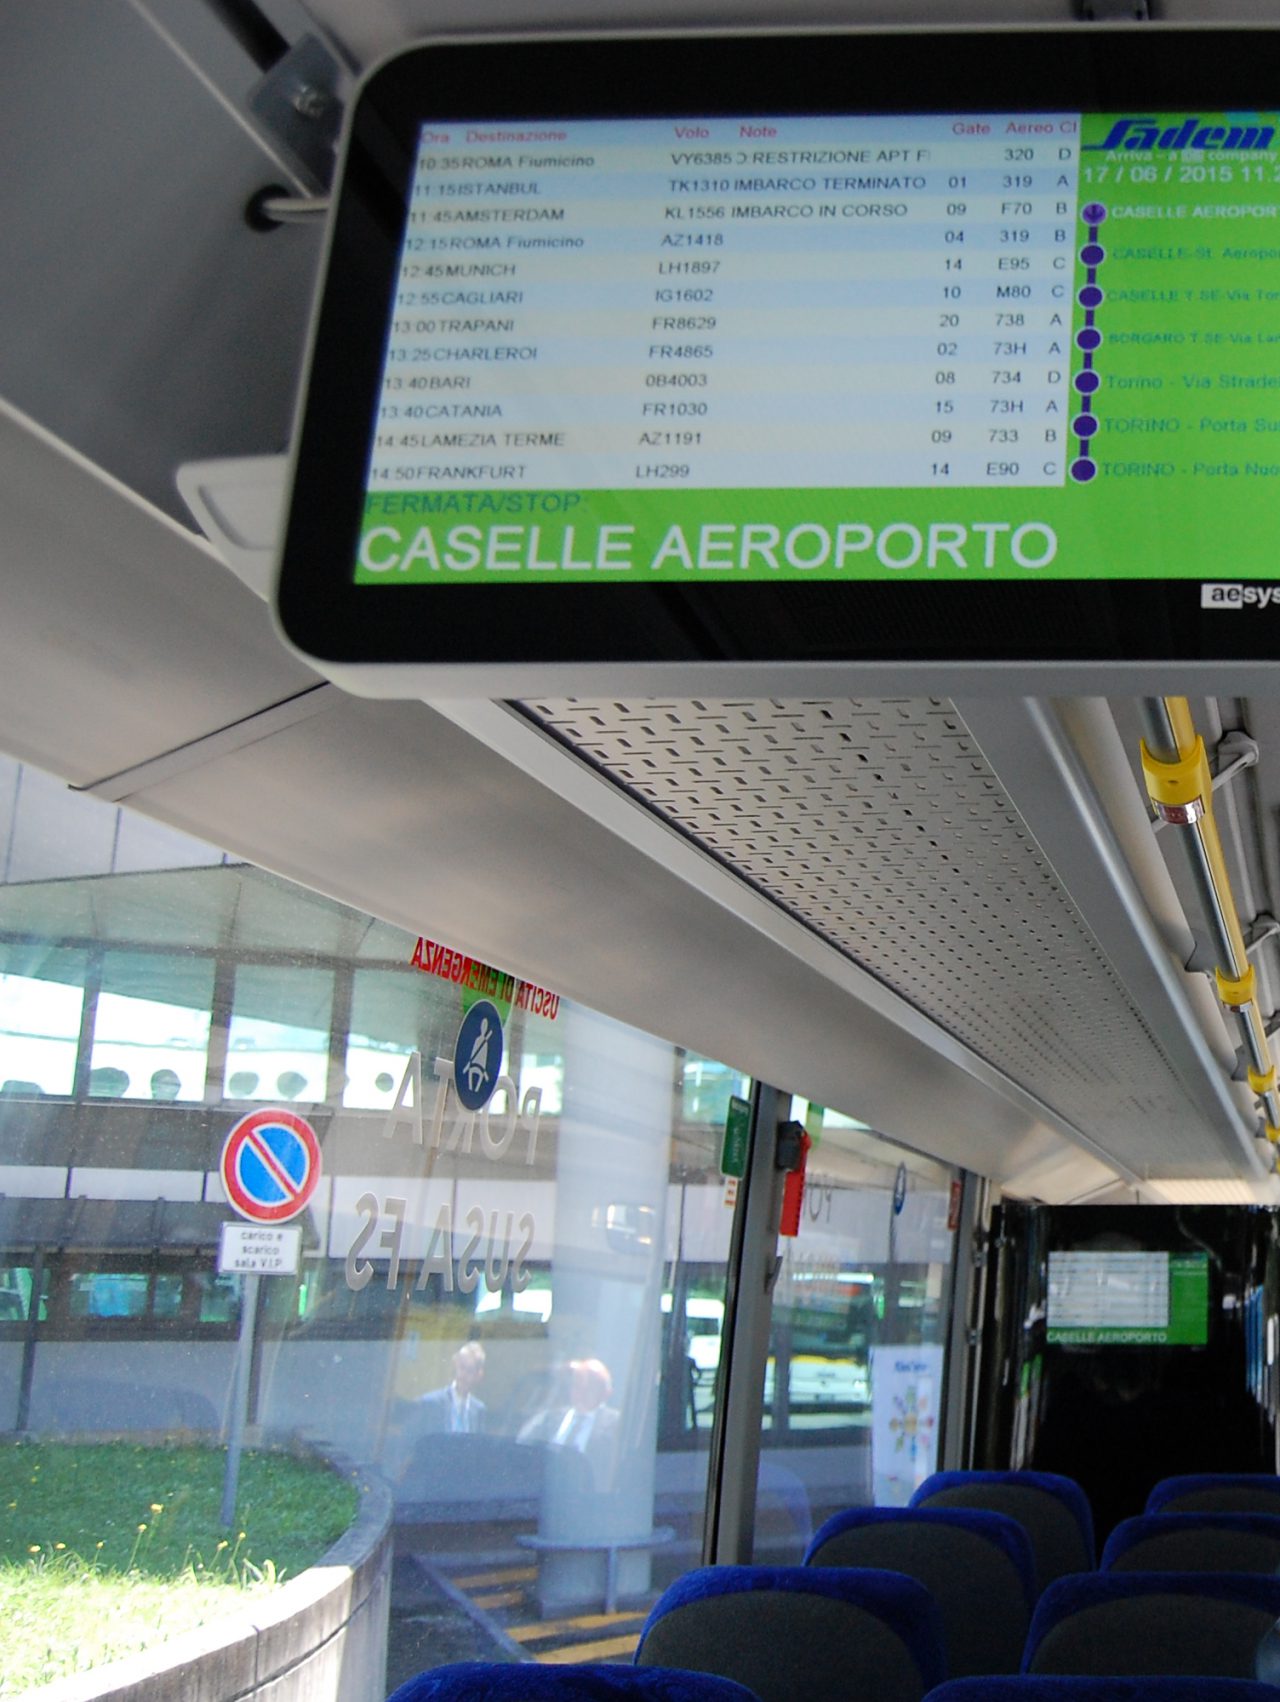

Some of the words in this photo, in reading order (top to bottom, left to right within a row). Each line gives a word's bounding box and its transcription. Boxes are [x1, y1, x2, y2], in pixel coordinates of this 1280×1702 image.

[466, 130, 567, 143] Destinazione
[674, 126, 710, 138] Volo
[739, 125, 778, 138] Note
[952, 122, 991, 135] Gate
[1006, 121, 1054, 134] Aereo
[462, 157, 513, 168] ROMA
[518, 155, 595, 168] Fiumicino
[671, 152, 732, 165] VY6385
[752, 150, 870, 165] RESTRIZIONE
[877, 150, 911, 162] APT
[1005, 148, 1034, 160] 320
[1059, 148, 1071, 160] D
[1084, 166, 1109, 183] 17
[1131, 166, 1158, 183] 06
[1180, 165, 1234, 183] 2015
[458, 182, 541, 195] ISTANBUL
[669, 179, 730, 192] TK1310
[734, 178, 816, 191] IMBARCO
[823, 176, 926, 190] TERMINATO
[949, 176, 967, 188] 01
[1003, 175, 1033, 188] 319
[1057, 175, 1069, 187] A
[456, 208, 565, 222] AMSTERDAM
[665, 206, 725, 219] KL1556
[731, 205, 813, 218] IMBARCO
[819, 205, 836, 217] IN
[842, 203, 908, 217] CORSO
[947, 203, 967, 216] 09
[1001, 202, 1032, 215] F70
[1056, 202, 1067, 214] B
[1111, 203, 1187, 218] CASELLE
[450, 237, 501, 250] ROMA
[506, 235, 585, 249] Fiumicino
[660, 234, 724, 247] AZ1418
[944, 230, 965, 243] 04
[1000, 229, 1030, 243] 319
[1055, 229, 1066, 242] B
[446, 264, 516, 277] MUNICH
[658, 261, 721, 274] LH1897
[944, 258, 962, 271] 14
[998, 257, 1030, 270] E95
[1053, 256, 1066, 270] C
[441, 290, 523, 305] CAGLIARI
[655, 289, 714, 302] IG1602
[943, 286, 961, 299] 10
[996, 285, 1031, 298] M80
[1051, 285, 1064, 298] C
[440, 320, 514, 332] TRAPANI
[652, 318, 716, 331] FR8629
[940, 314, 959, 327] 20
[995, 313, 1025, 327] 738
[1050, 313, 1062, 326] A
[433, 347, 538, 361] CHARLEROI
[648, 345, 713, 359] FR4865
[937, 342, 958, 356] 02
[993, 342, 1027, 355] 73H
[1048, 342, 1061, 355] A
[430, 377, 471, 390] BARI
[935, 371, 956, 385] 08
[991, 371, 1022, 384] 734
[1047, 371, 1061, 384] D
[1106, 375, 1163, 389] Torino
[1182, 375, 1212, 389] Via
[425, 404, 503, 418] CATANIA
[641, 403, 708, 416] FR1030
[934, 400, 954, 414] 15
[990, 400, 1024, 414] 73H
[1045, 400, 1059, 413] A
[1104, 417, 1181, 433] TORINO
[1199, 417, 1248, 432] Porta
[421, 434, 497, 447] LAMEZIA
[504, 433, 566, 447] TERME
[637, 432, 702, 446] AZ1191
[931, 430, 952, 444] 09
[988, 430, 1019, 443] 733
[1044, 430, 1057, 443] B
[417, 465, 527, 480] FRANKFURT
[635, 465, 690, 479] LH299
[931, 463, 950, 476] 14
[986, 462, 1020, 476] E90
[1043, 462, 1057, 476] C
[1102, 461, 1175, 477] TORINO
[1193, 461, 1239, 476] Porta
[360, 524, 636, 573] CASELLE
[650, 521, 1059, 570] AEROPORTO
[241, 1231, 273, 1241] carico
[242, 1245, 280, 1256] scarico
[235, 1257, 256, 1268] sala
